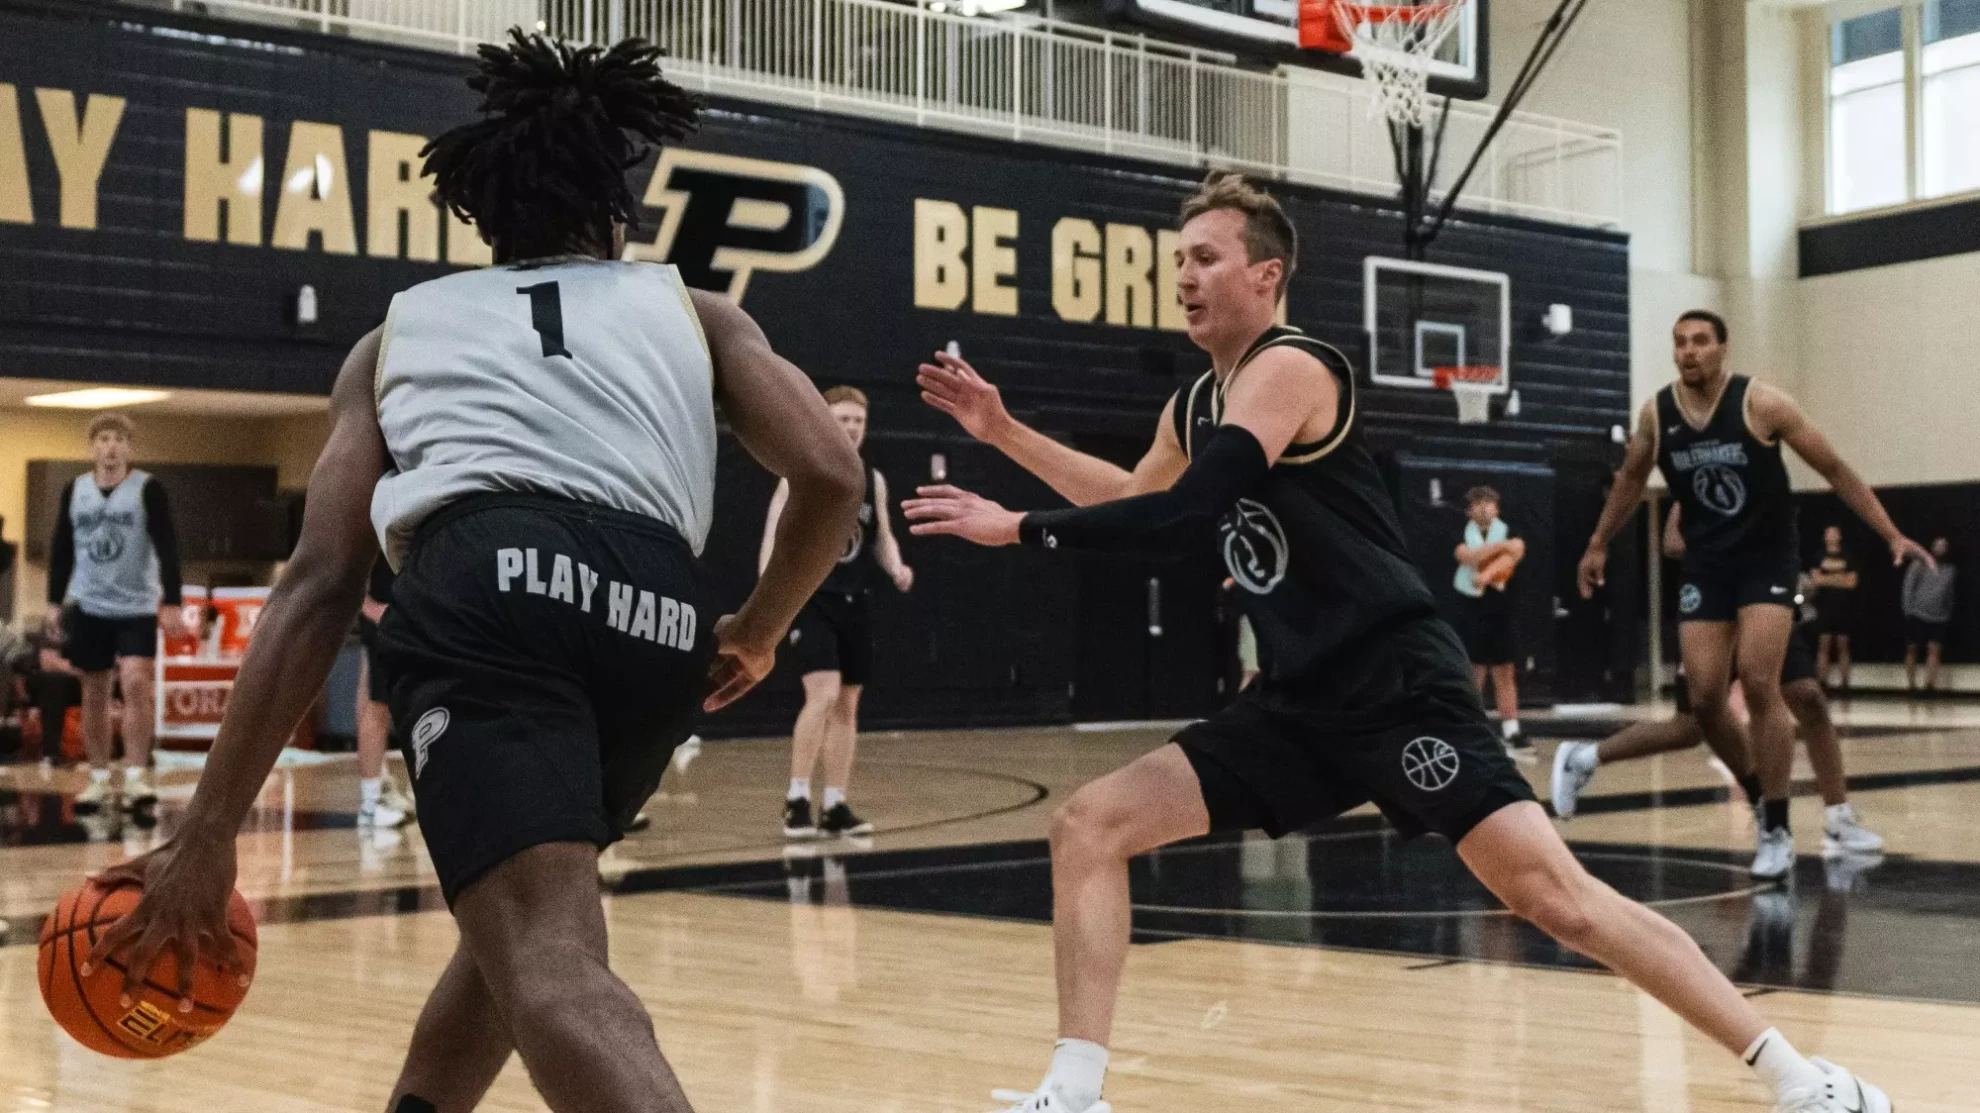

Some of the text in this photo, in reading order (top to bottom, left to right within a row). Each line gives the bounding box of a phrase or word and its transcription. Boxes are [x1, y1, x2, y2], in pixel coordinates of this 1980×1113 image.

[183, 107, 496, 266] HAR
[620, 148, 845, 307] P
[516, 280, 573, 360] 1
[914, 198, 1288, 334] BE GRE
[497, 547, 697, 652] PLAY HARD
